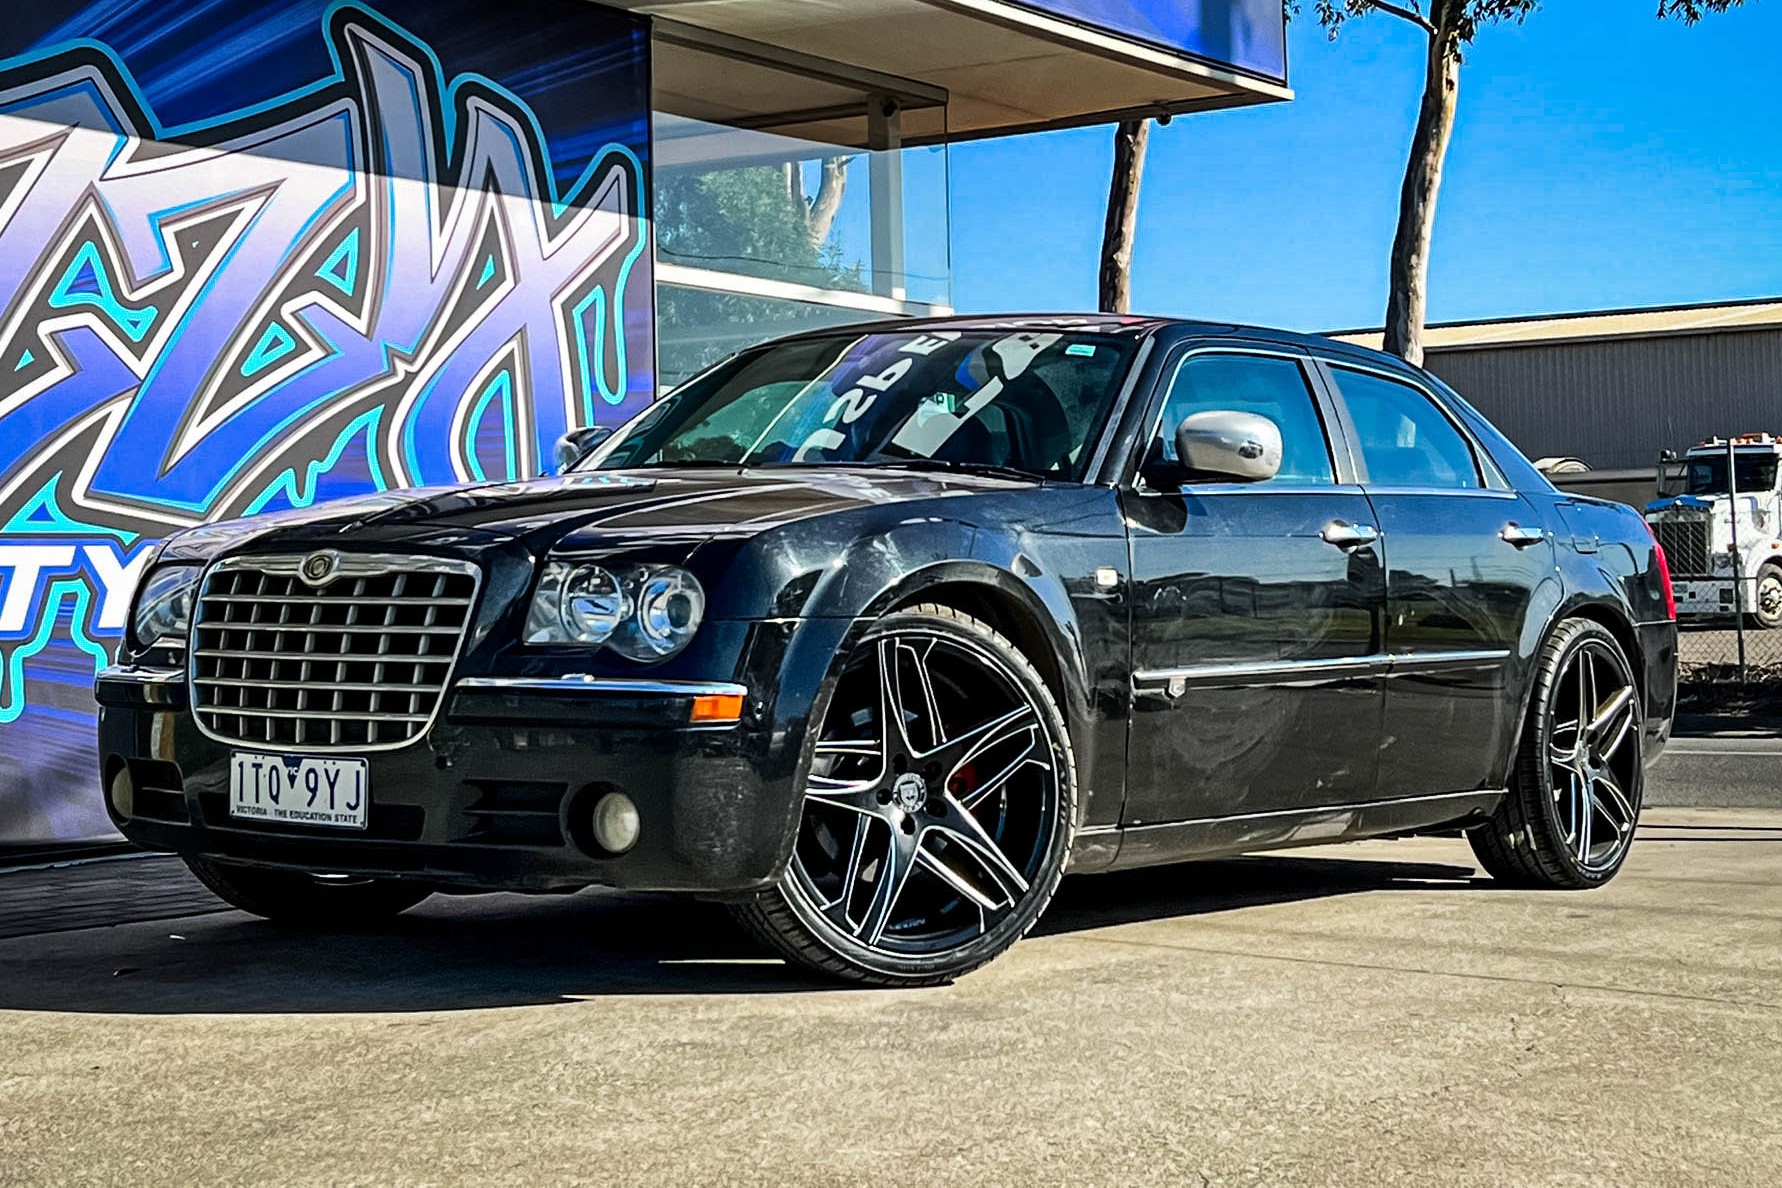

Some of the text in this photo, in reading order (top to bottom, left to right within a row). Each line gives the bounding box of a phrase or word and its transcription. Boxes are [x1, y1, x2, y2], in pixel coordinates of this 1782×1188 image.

[305, 767, 361, 811] 9YJ
[236, 805, 358, 824] VICTORIA THE EDUCATION STATE
